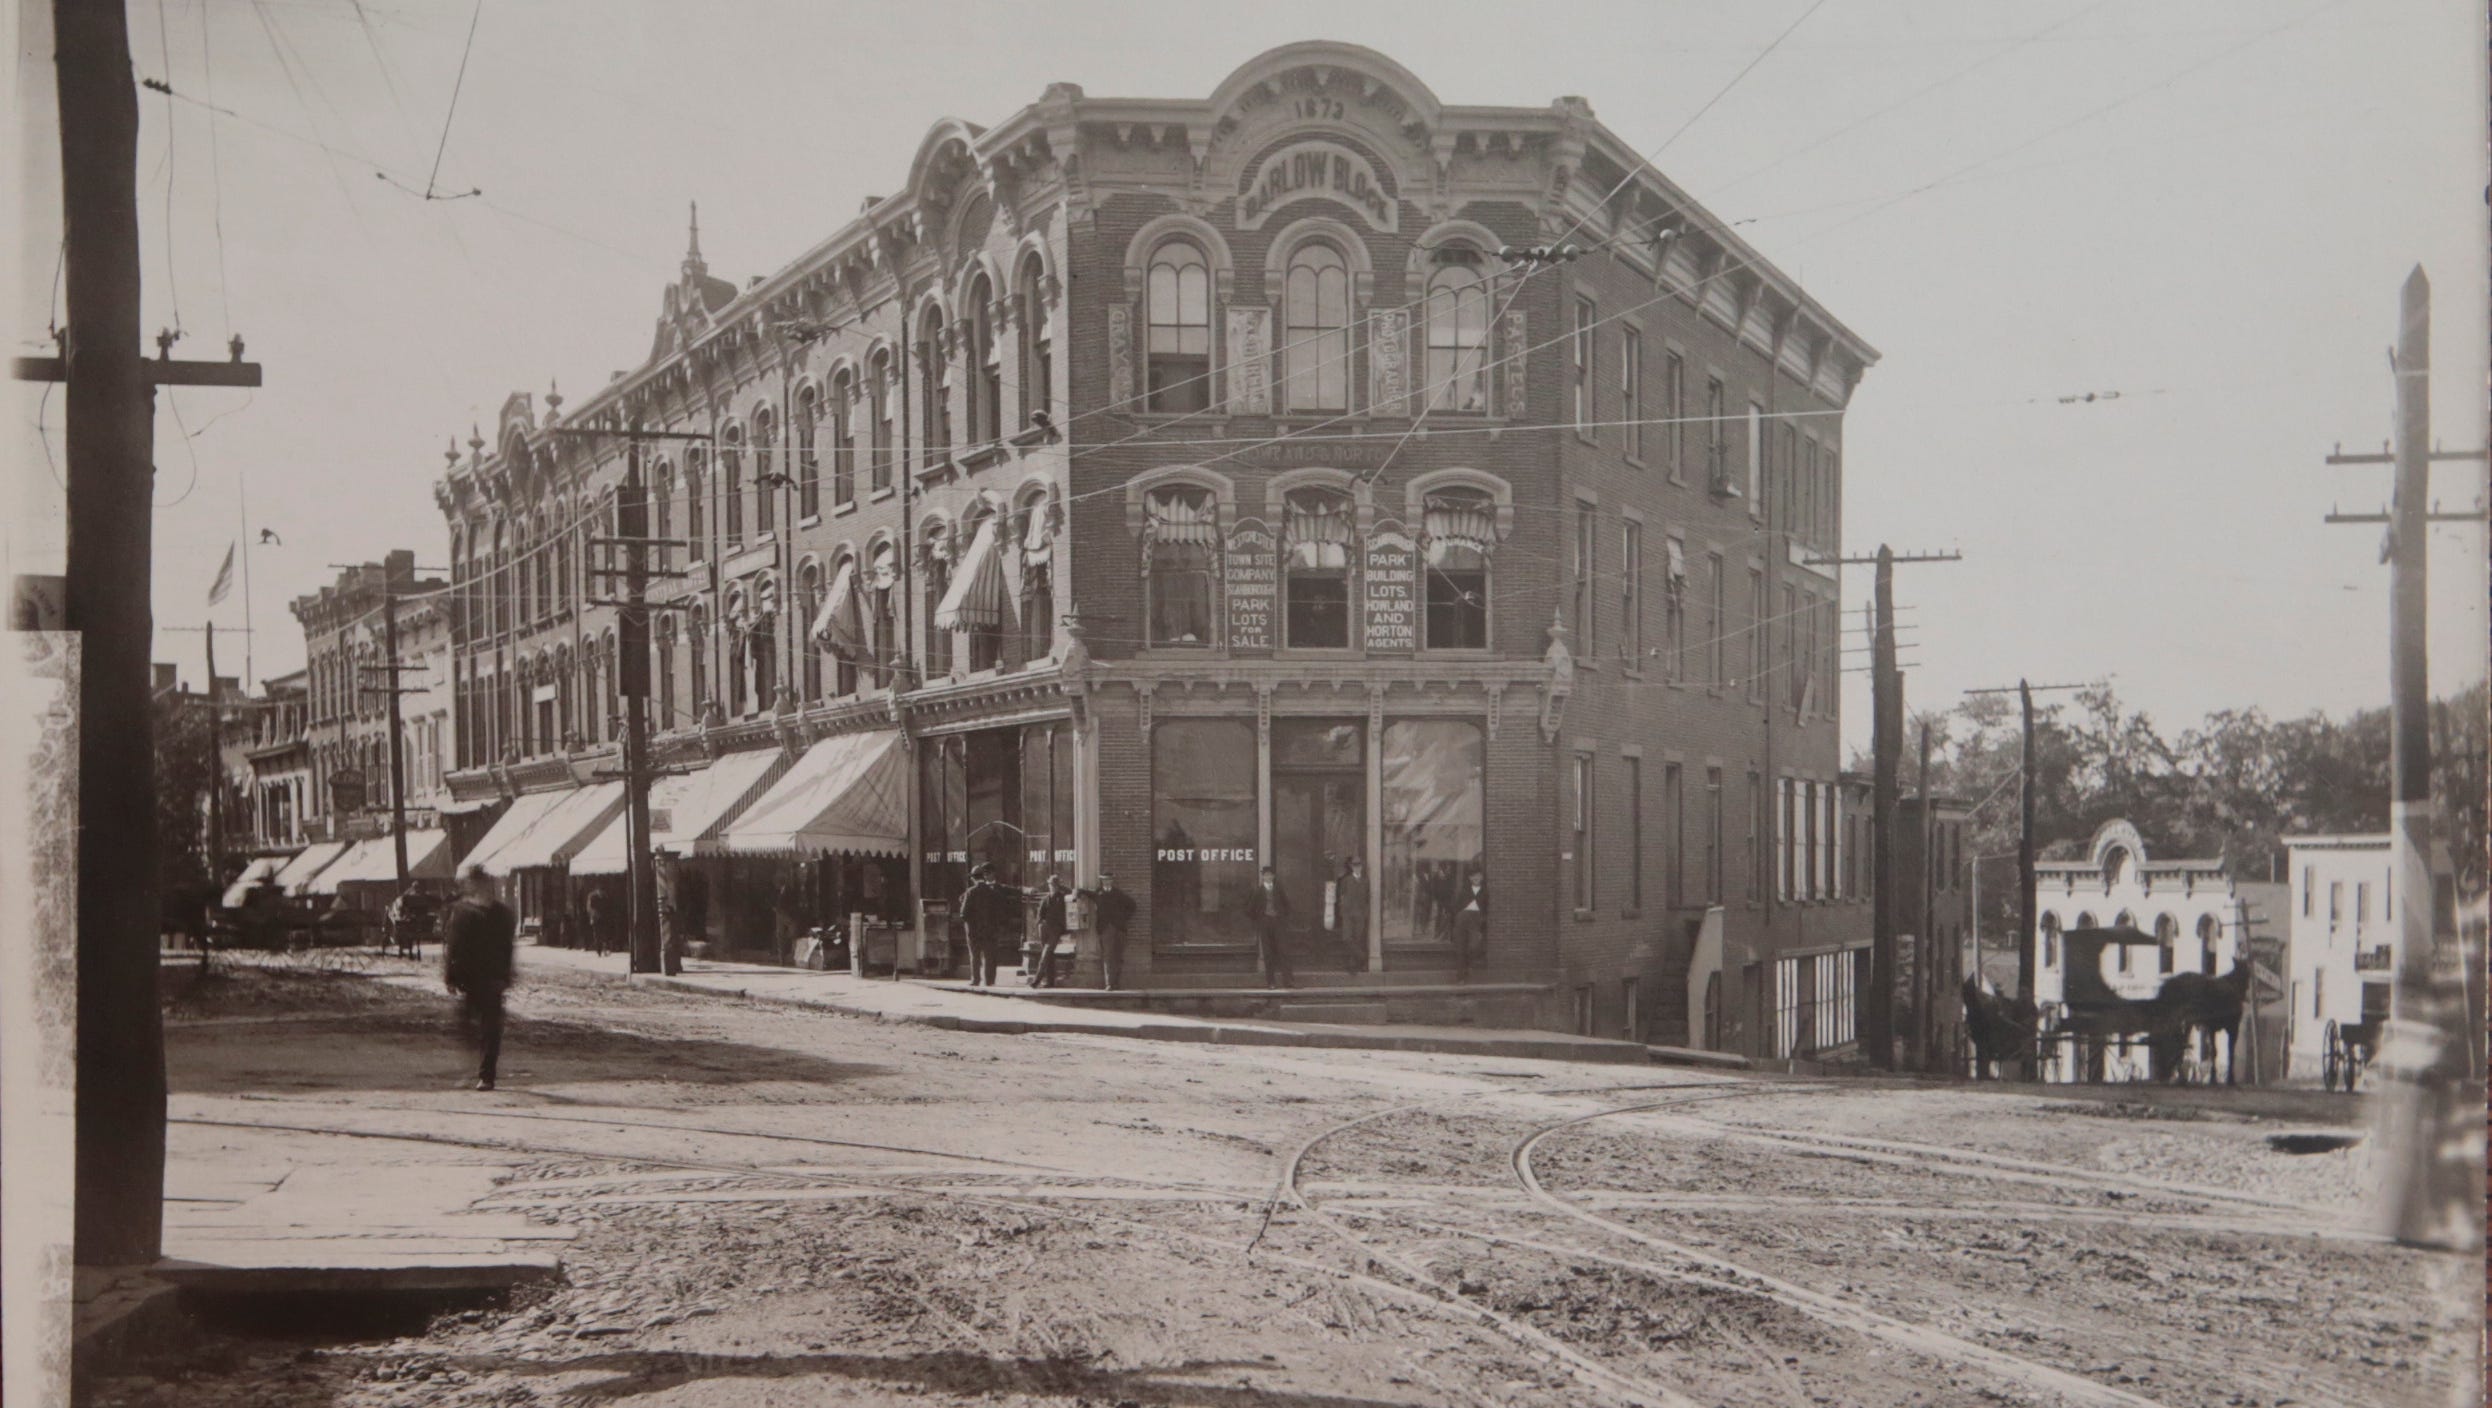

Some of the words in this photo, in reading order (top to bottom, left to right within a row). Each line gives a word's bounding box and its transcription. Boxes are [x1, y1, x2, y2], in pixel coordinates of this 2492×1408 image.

[1245, 151, 1328, 221] BARLOW
[1333, 154, 1388, 225] BLOCK
[1505, 312, 1525, 414] PASTELS
[1227, 553, 1252, 566] TOWN
[1254, 553, 1275, 566] SITE
[1227, 568, 1275, 581] COMPANY
[1366, 570, 1414, 582] BUILDING
[1366, 600, 1414, 612] HOWLAND
[1231, 613, 1268, 626] LOTS
[1373, 612, 1405, 624] AND
[1240, 626, 1263, 634] FOR
[1366, 625, 1413, 638] HORTON
[925, 851, 941, 863] POST
[946, 850, 967, 863] OFFICE
[1029, 849, 1047, 863] POST
[1054, 849, 1076, 863] OFFIC
[1157, 848, 1195, 862] POST
[1200, 848, 1254, 862] OFFICE
